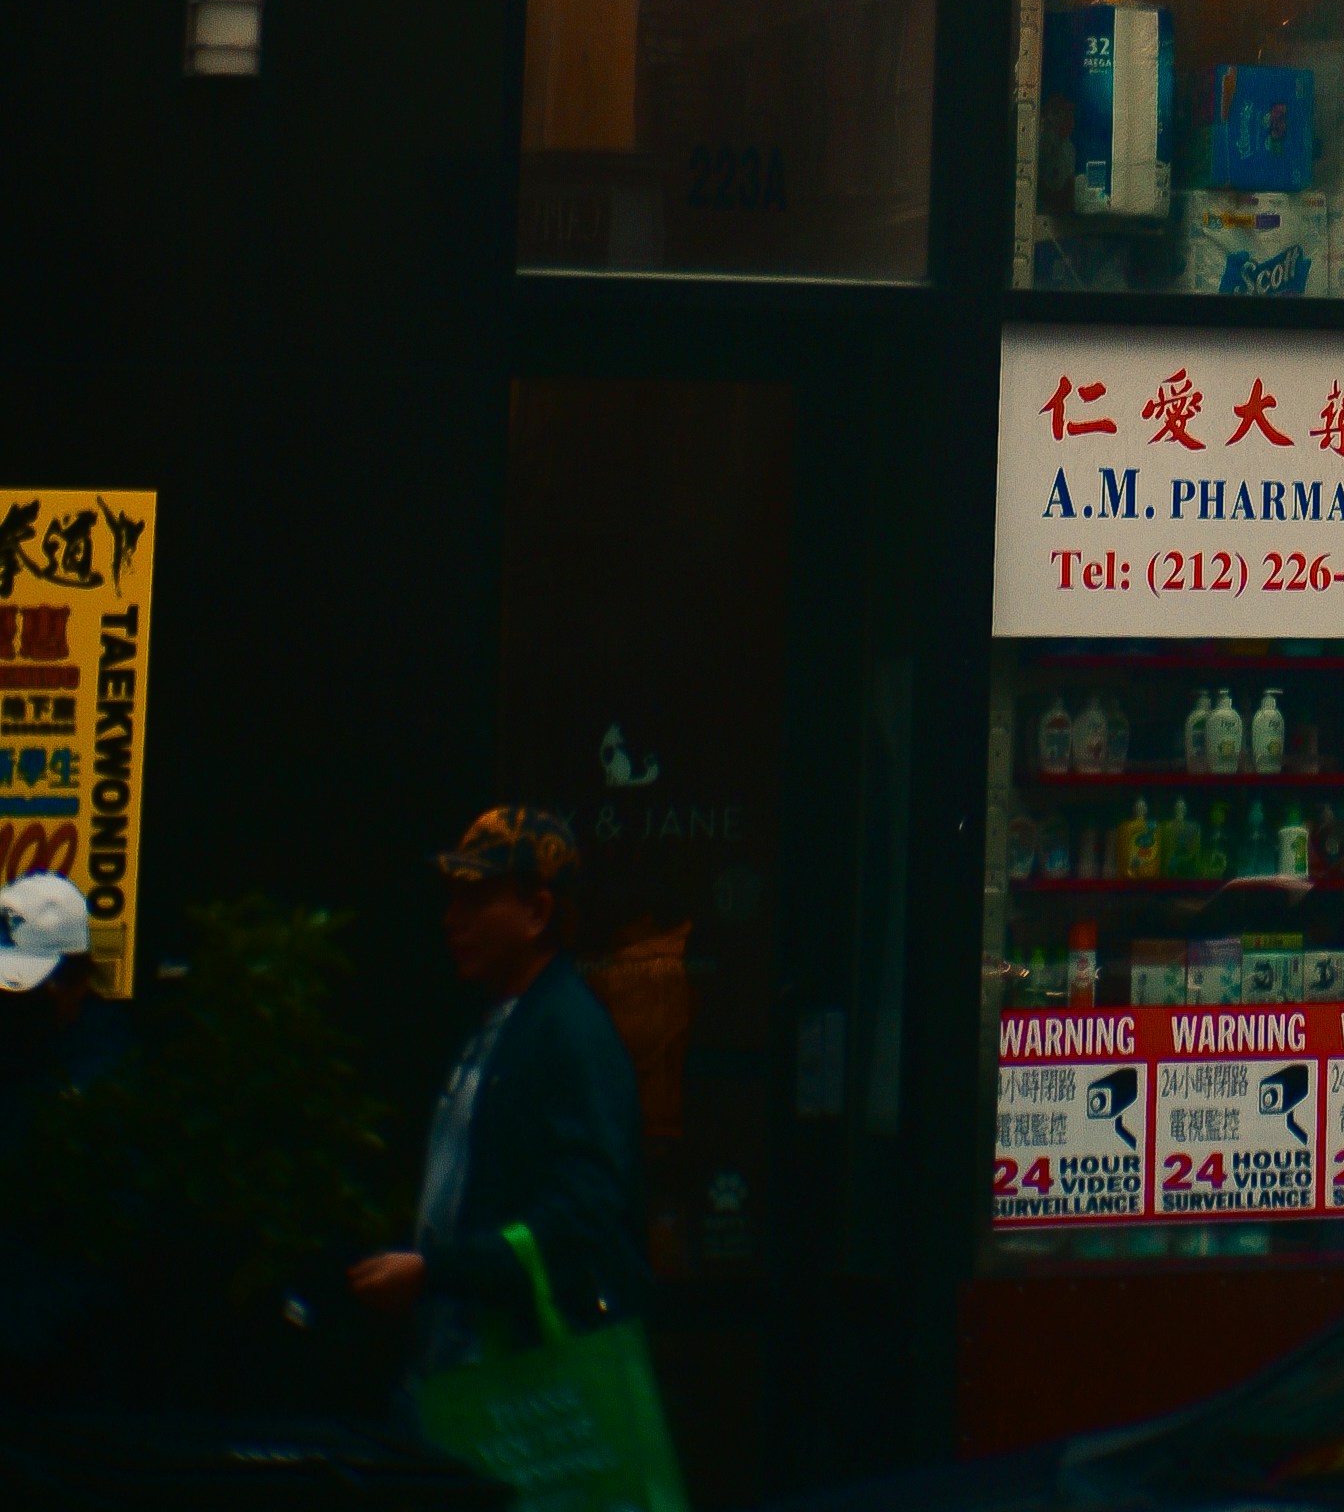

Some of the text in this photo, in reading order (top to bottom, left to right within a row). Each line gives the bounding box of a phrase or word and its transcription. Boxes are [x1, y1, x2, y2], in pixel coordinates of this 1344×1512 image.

[1085, 37, 1111, 56] 32
[1237, 246, 1300, 294] Scott
[1043, 466, 1155, 520] A.M.
[1051, 550, 1131, 592] Tel:
[1147, 551, 1248, 598] (212)
[88, 604, 139, 920] TAEKWONDO
[640, 805, 743, 841] JANE
[1000, 1016, 1136, 1058] WARNING
[1171, 1013, 1306, 1054] WARNING
[992, 1155, 1141, 1196] 24 HOUR
[1060, 1175, 1141, 1195] VIDEO
[1163, 1149, 1312, 1190] 24 HOUR
[1233, 1169, 1312, 1189] VIDEO
[993, 1195, 1140, 1218] SURVEILLANCE
[1162, 1188, 1311, 1212] SURVEILLANCE
